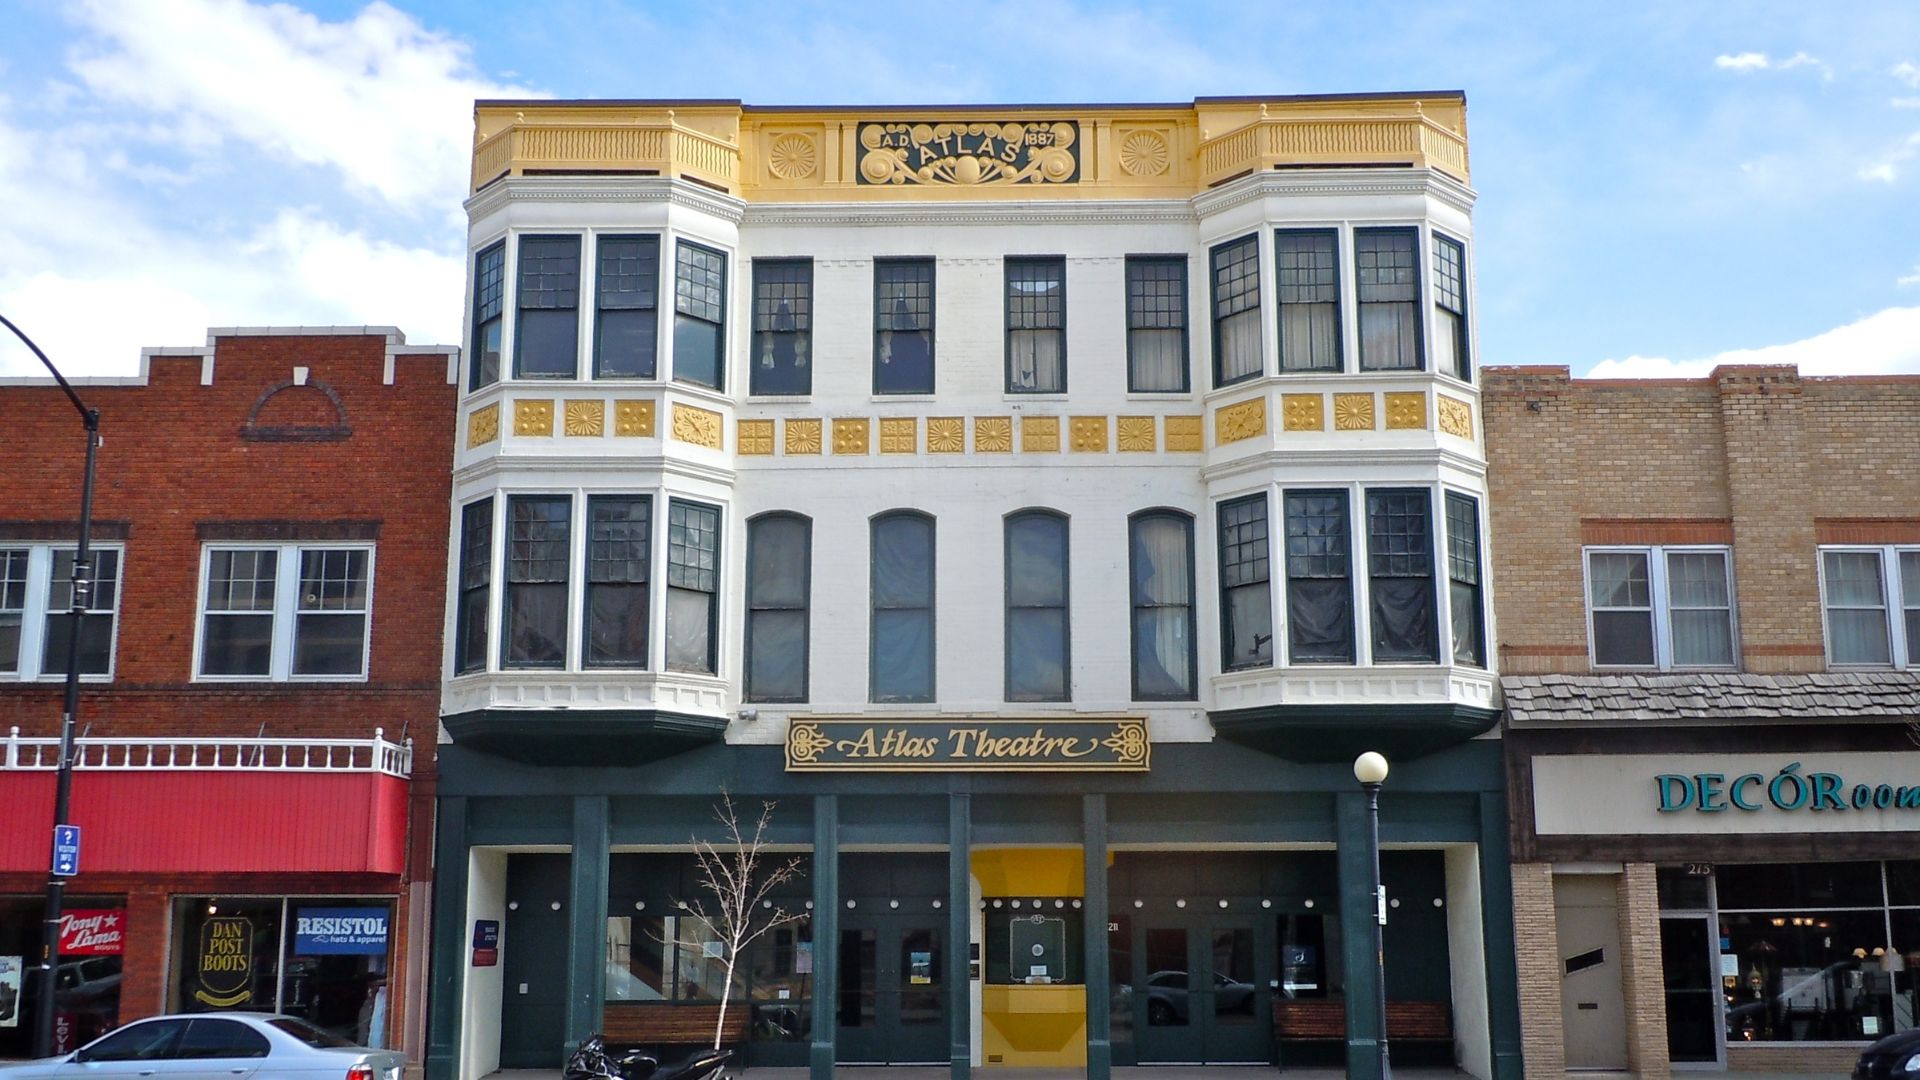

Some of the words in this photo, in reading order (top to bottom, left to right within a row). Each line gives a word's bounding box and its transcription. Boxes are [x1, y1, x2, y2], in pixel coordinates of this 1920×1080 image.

[1025, 133, 1055, 146] 1887
[920, 136, 1020, 165] ATLAS
[836, 727, 938, 758] Atlas
[948, 728, 1099, 759] Theatre
[1688, 864, 1710, 875] 215
[60, 914, 103, 938] Tony
[213, 922, 243, 938] DAN
[296, 917, 387, 935] RESISTOL
[66, 930, 121, 949] Lama
[209, 938, 244, 954] POST
[330, 935, 348, 943] hats
[356, 936, 386, 945] apparel
[203, 954, 248, 971] BOOTS
